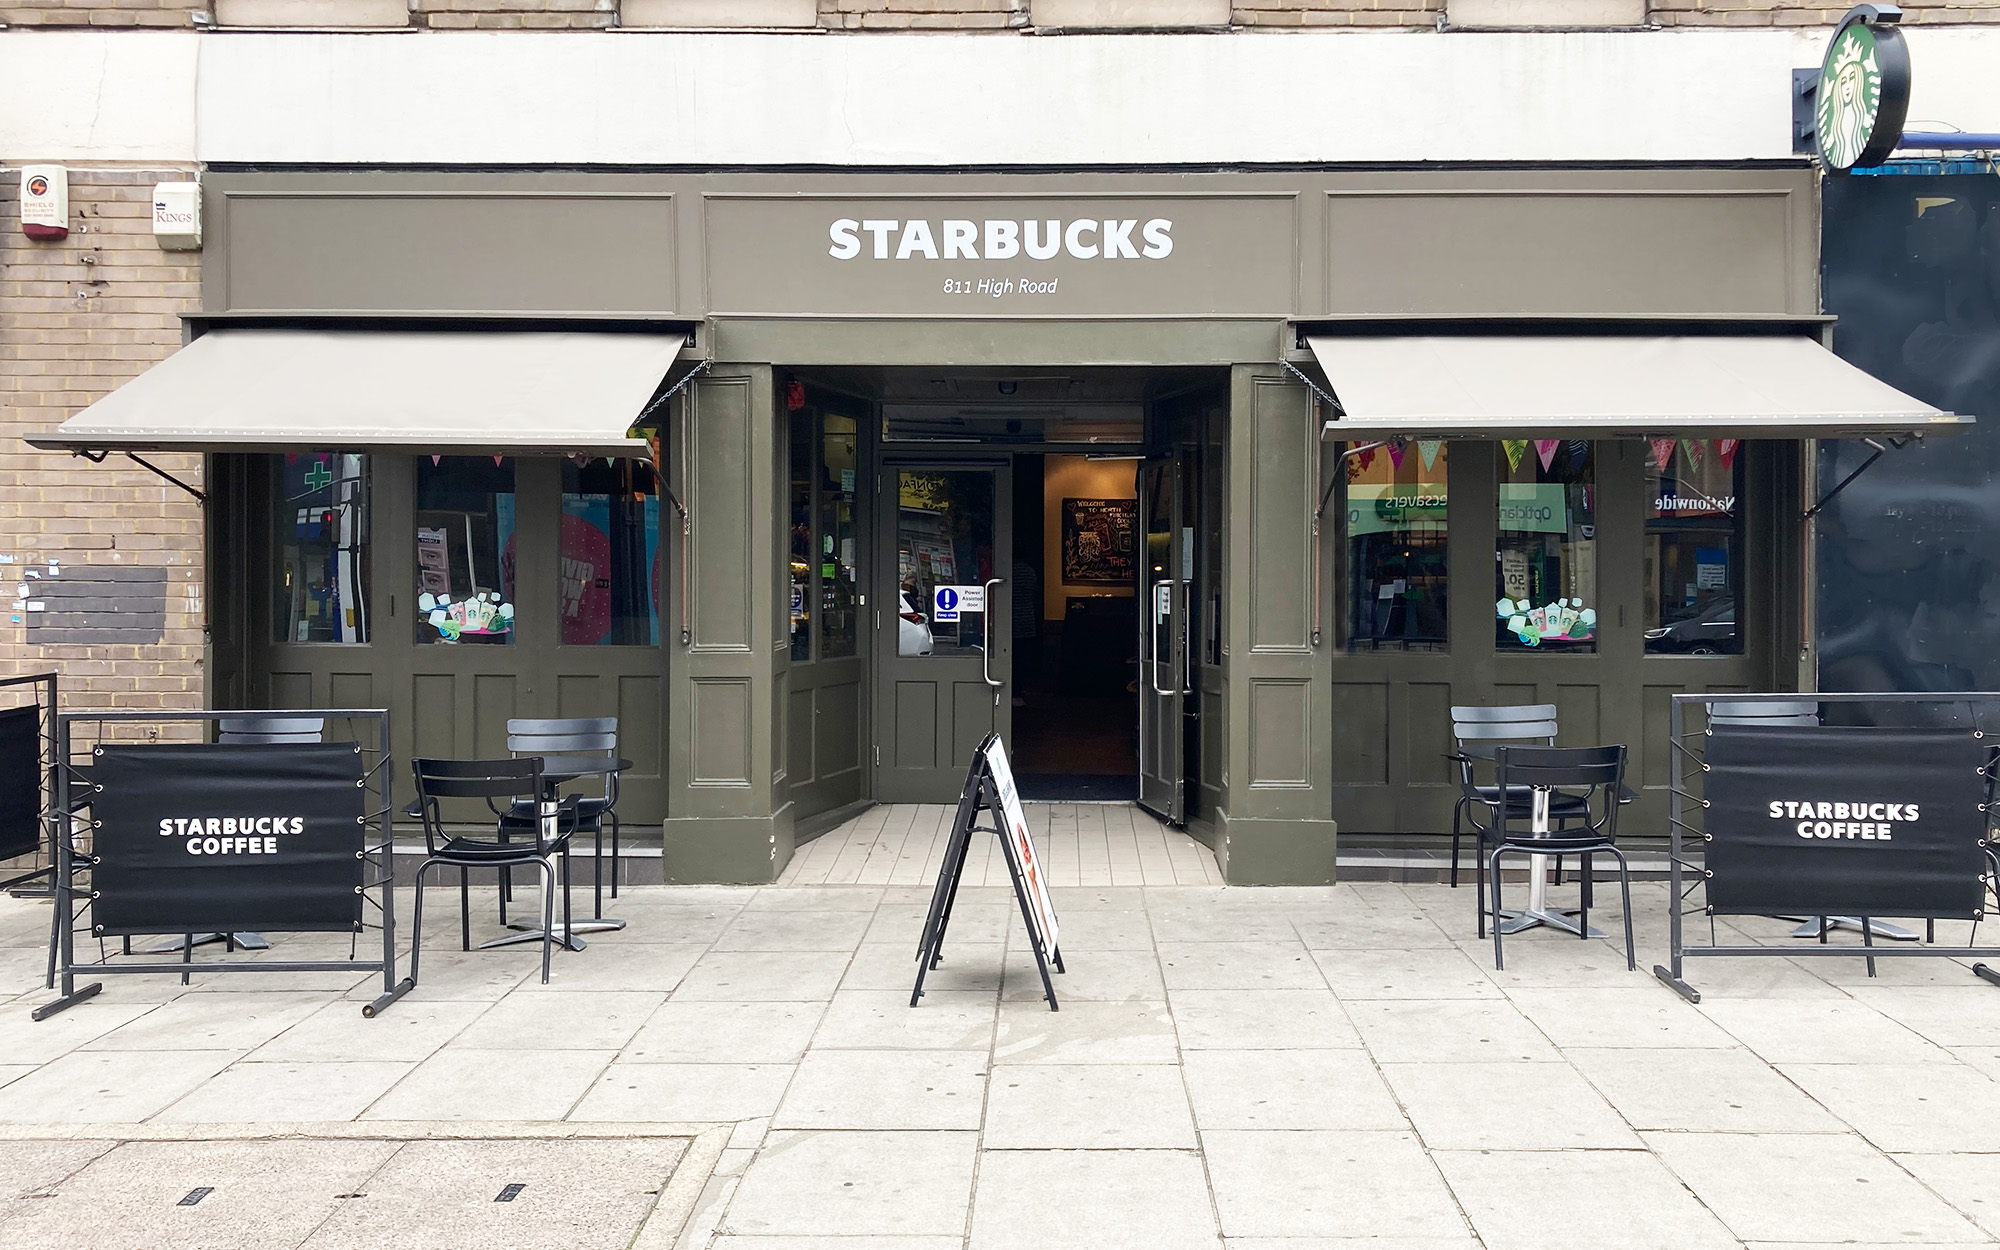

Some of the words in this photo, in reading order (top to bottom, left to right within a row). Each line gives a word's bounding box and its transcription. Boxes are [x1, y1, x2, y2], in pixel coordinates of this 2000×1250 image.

[828, 218, 1174, 261] STARBUCKS
[943, 278, 972, 294] 811
[977, 278, 1014, 298] High
[1018, 278, 1059, 294] Road
[1106, 556, 1132, 566] THEY
[1769, 801, 1920, 821] STARBUCKS
[159, 817, 304, 836] STARBUCKS
[1797, 821, 1892, 840] COFFEE
[186, 837, 278, 855] COFFEE
